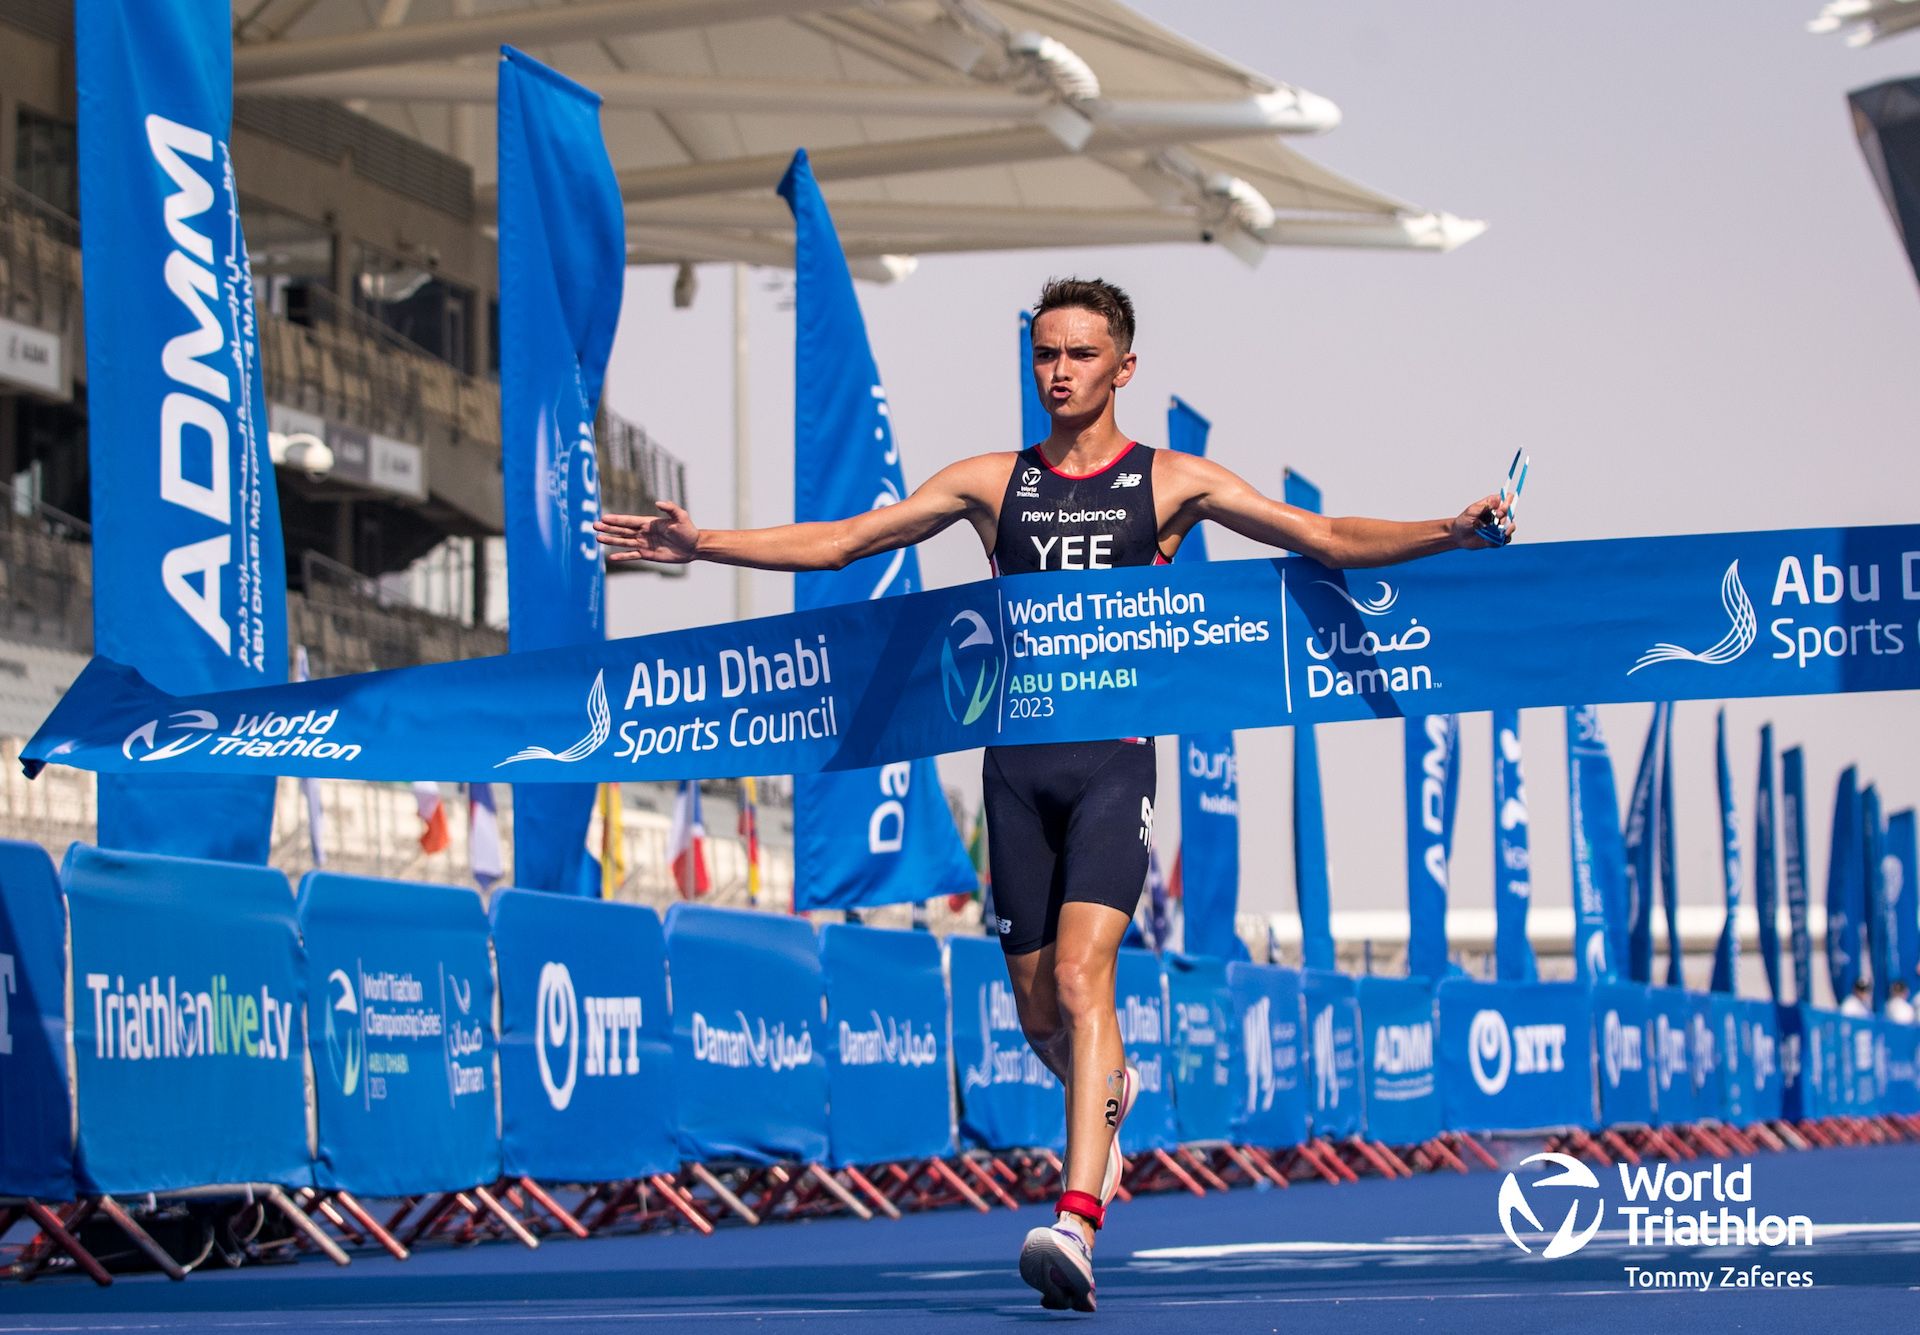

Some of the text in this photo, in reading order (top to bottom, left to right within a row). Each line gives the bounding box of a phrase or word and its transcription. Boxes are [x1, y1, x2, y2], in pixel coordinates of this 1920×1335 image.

[145, 114, 231, 657] ADMM
[1022, 508, 1127, 523] new balance
[250, 534, 263, 614] DHABI
[1030, 534, 1114, 571] YEE
[1771, 553, 1880, 606] Abu
[1008, 586, 1205, 625] World Triathlon
[252, 618, 265, 673] ABU
[1013, 615, 1270, 660] Championship Series
[1306, 617, 1431, 660] ضمان
[1770, 617, 1905, 669] Sports
[624, 634, 833, 711] Abu Dhabi
[1009, 667, 1138, 695] ABU DHABI
[1307, 664, 1432, 699] Daman
[231, 709, 339, 737] World
[613, 695, 838, 764] Sports Council
[1009, 696, 1055, 719] 2023
[209, 734, 362, 761] Triathlon
[1422, 714, 1448, 897] ADM
[87, 972, 293, 1061] Triathlonlive.tv
[584, 996, 642, 1077] NTT
[692, 1011, 750, 1068] Daman
[839, 1020, 880, 1066] Daman
[1374, 1020, 1434, 1075] ADMM
[1513, 1024, 1567, 1075] NTT
[1105, 1098, 1120, 1127] 2
